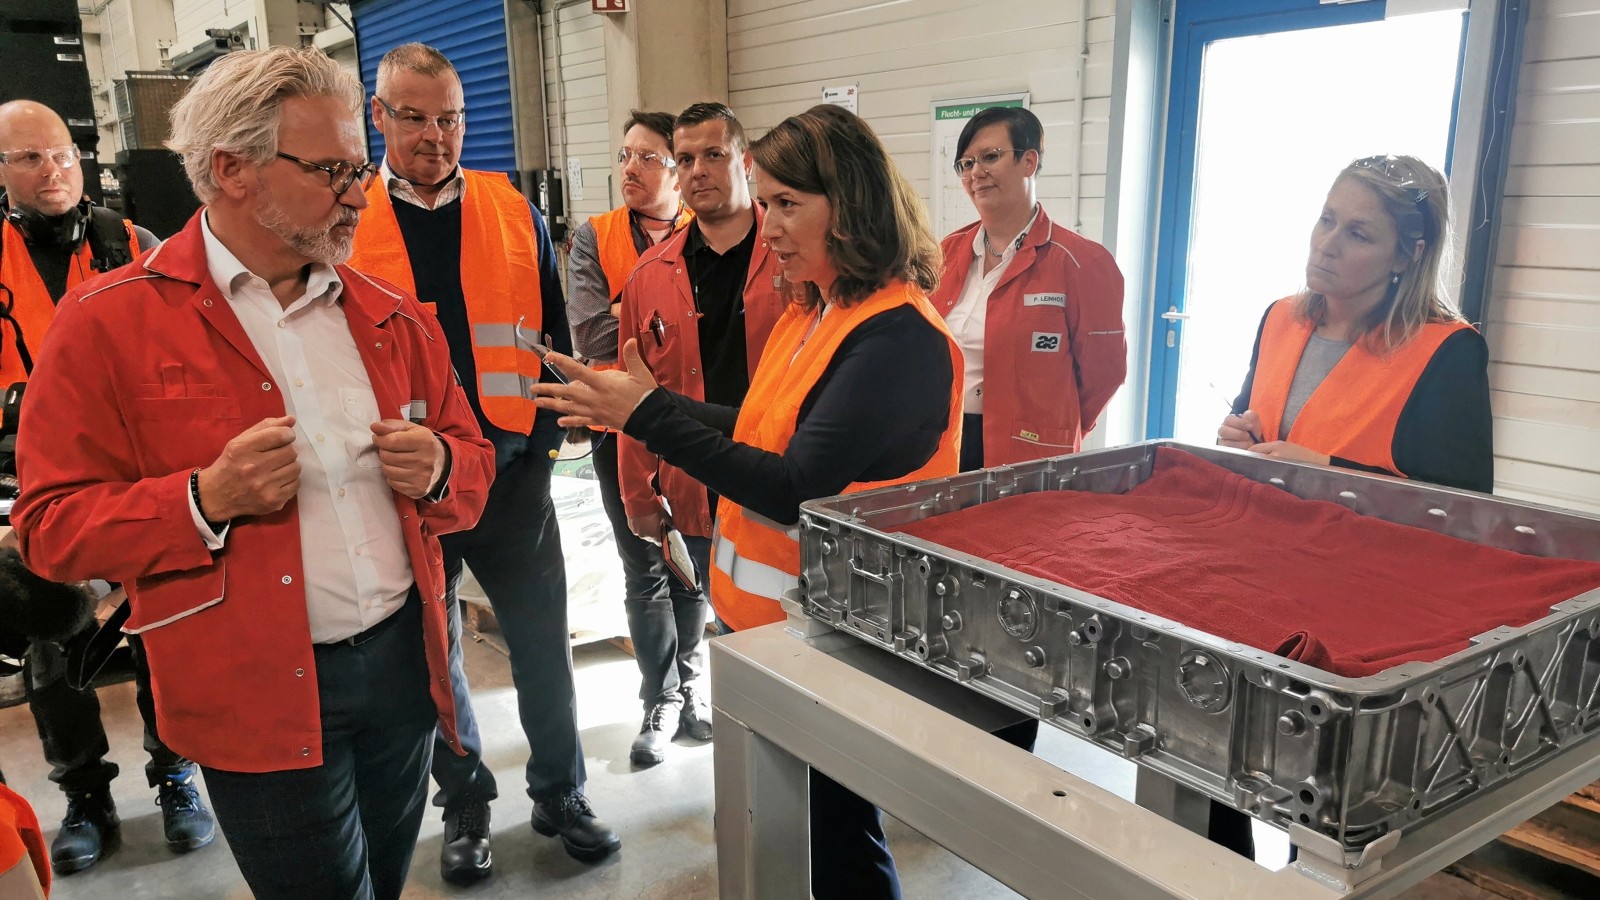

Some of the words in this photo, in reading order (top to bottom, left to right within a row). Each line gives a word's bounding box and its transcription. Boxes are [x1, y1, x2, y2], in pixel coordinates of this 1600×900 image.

[941, 109, 961, 118] Flucht-
[962, 108, 974, 117] und
[1040, 295, 1064, 303] LEINHOS
